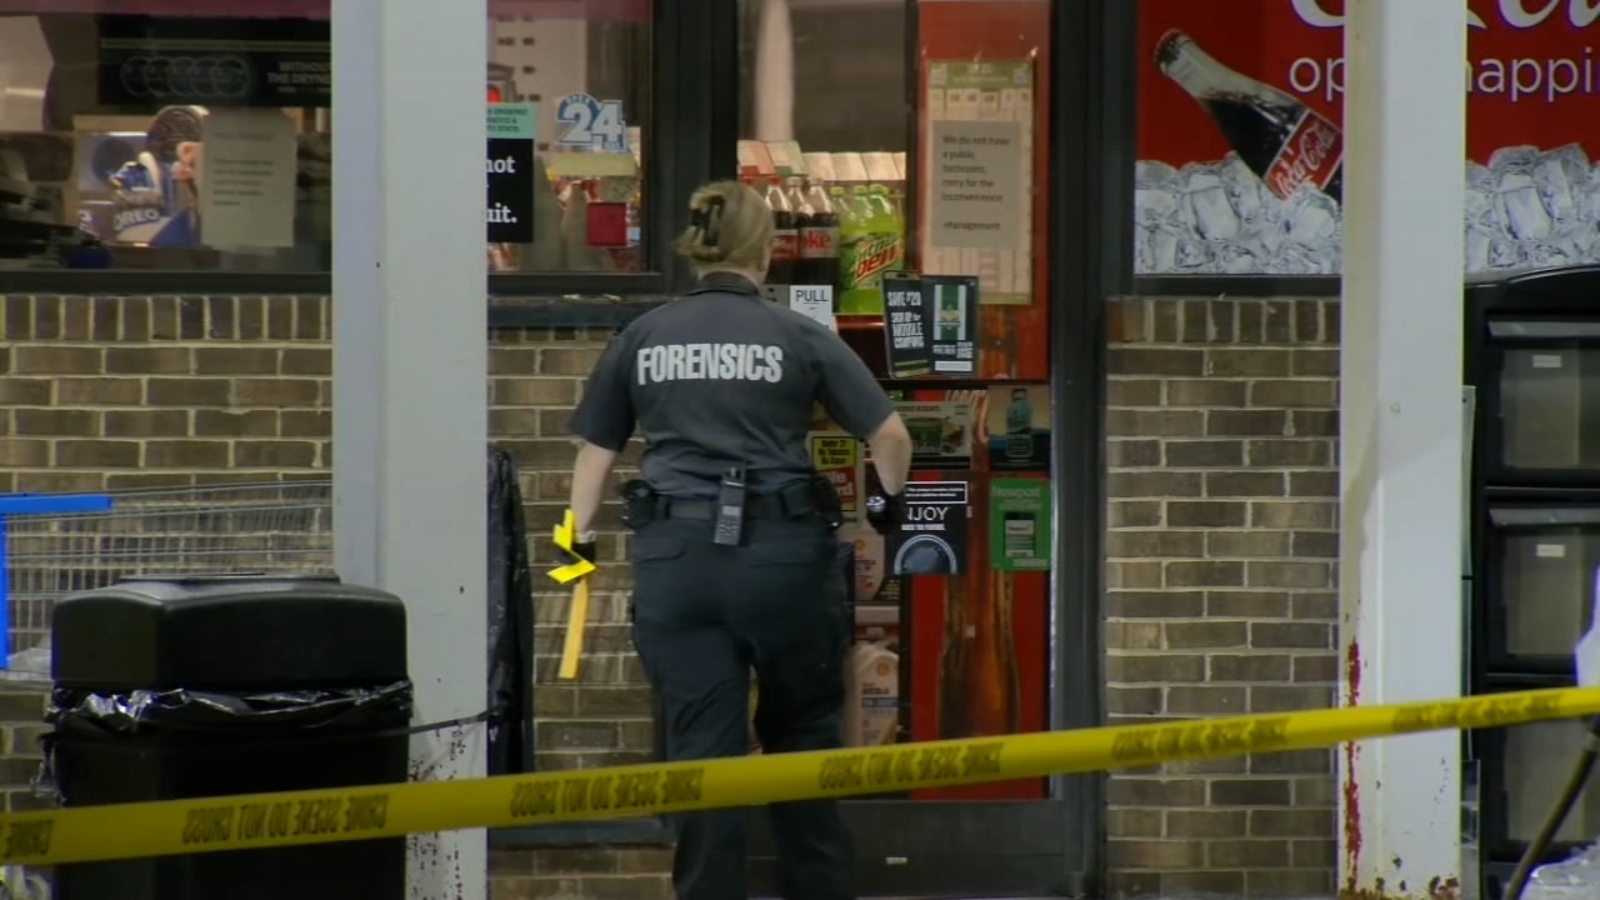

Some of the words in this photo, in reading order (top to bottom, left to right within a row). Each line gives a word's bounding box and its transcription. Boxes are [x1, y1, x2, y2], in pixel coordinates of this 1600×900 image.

[1289, 57, 1345, 101] op
[559, 99, 624, 145] 24
[973, 136, 986, 145] not
[989, 136, 1010, 145] have
[950, 151, 974, 160] public
[965, 178, 977, 187] for
[979, 179, 994, 187] the
[113, 208, 159, 231] OREO
[486, 203, 517, 223] uit.
[796, 290, 828, 302] PULL
[887, 291, 906, 306] SAVE
[637, 343, 783, 386] FORENSICS
